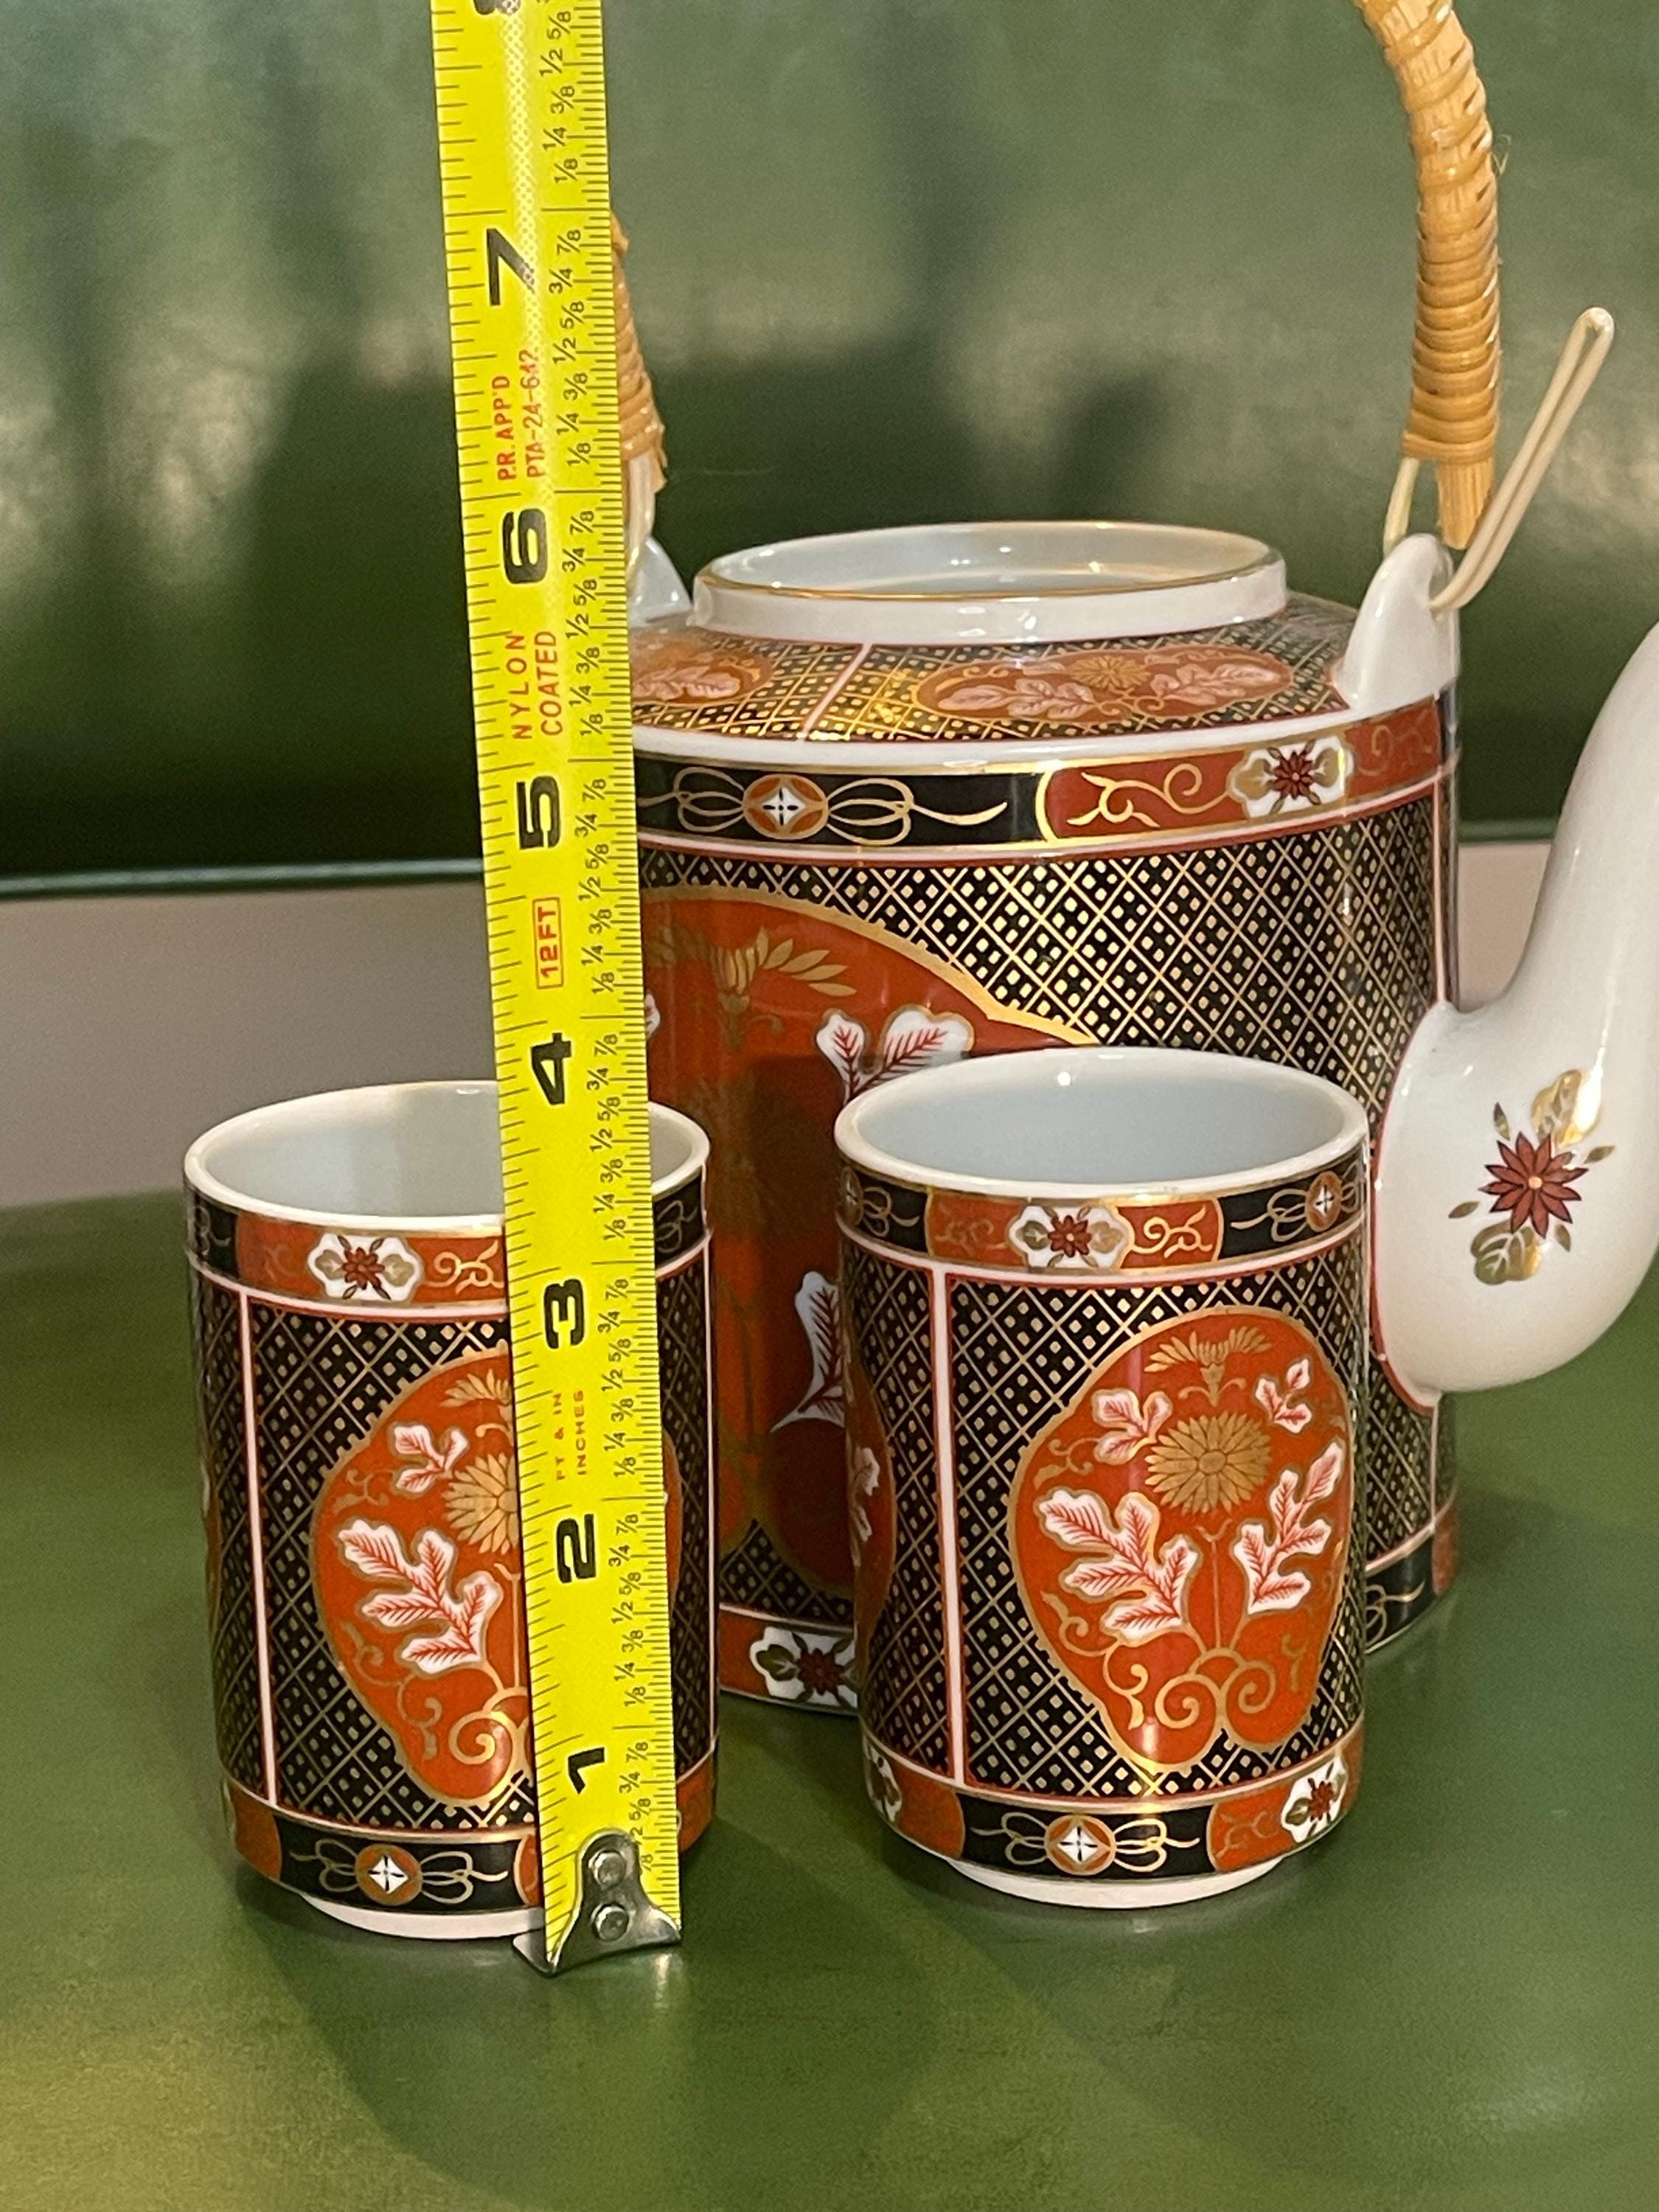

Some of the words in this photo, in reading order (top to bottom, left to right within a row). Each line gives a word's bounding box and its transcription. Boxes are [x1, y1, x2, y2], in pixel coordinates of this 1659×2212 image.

[547, 10, 571, 39] 5/8
[539, 48, 563, 77] 1/2
[550, 86, 575, 114] 3/8
[543, 127, 566, 150] 1/4
[554, 158, 578, 183] 1/8
[557, 229, 581, 254] 7/8
[487, 228, 535, 306] 7
[549, 268, 573, 293] 3/4
[560, 301, 585, 329] 5/8
[552, 337, 577, 364] 1/2
[563, 372, 588, 400] 3/8
[557, 413, 580, 435] 1/4
[566, 442, 591, 466] 1/8
[570, 510, 594, 535] 7/8
[503, 508, 547, 584] 6
[563, 548, 585, 572] 3/4
[573, 579, 597, 606] 5/8
[566, 613, 589, 639] 1/2
[576, 647, 600, 674] 3/8
[505, 635, 533, 740] NYLON
[535, 630, 563, 735] COATED
[568, 685, 591, 706] 1/4
[580, 714, 603, 737] 1/8
[582, 779, 606, 802] 7/8
[516, 776, 560, 849] 5
[575, 814, 597, 838] 3/4
[585, 844, 609, 869] 5/8
[578, 876, 601, 902] 1/2
[588, 909, 612, 934] 3/8
[581, 945, 604, 965] 1/4
[591, 972, 615, 994] 1/8
[594, 1034, 618, 1057] 7/8
[530, 1032, 571, 1105] 4
[587, 1068, 609, 1091] 3/4
[597, 1096, 621, 1121] 5/8
[590, 1128, 612, 1152] 1/2
[600, 1158, 624, 1183] 3/8
[593, 1194, 615, 1213] 1/4
[602, 1219, 626, 1240] 1/8
[605, 1279, 629, 1301] 7/8
[543, 1279, 585, 1349] 3
[597, 1311, 620, 1334] 3/4
[608, 1338, 631, 1362] 5/8
[601, 1369, 624, 1392] 1/2
[552, 1393, 562, 1415] IN
[611, 1398, 633, 1422] 3/8
[573, 1390, 587, 1475] INCHES
[604, 1432, 626, 1452] 1/4
[556, 1455, 566, 1481] FT
[613, 1457, 636, 1478] 1/8
[616, 1514, 639, 1536] 7/8
[556, 1514, 597, 1584] 2
[608, 1544, 630, 1568] 3/4
[619, 1572, 641, 1596] 5/8
[611, 1600, 634, 1624] 1/2
[622, 1630, 644, 1653] 3/8
[614, 1662, 636, 1681] 1/4
[625, 1686, 646, 1707] 1/8
[626, 1742, 648, 1763] 7/8
[568, 1746, 605, 1795] 1
[619, 1771, 641, 1794] 3/4
[629, 1798, 651, 1820] 5/8
